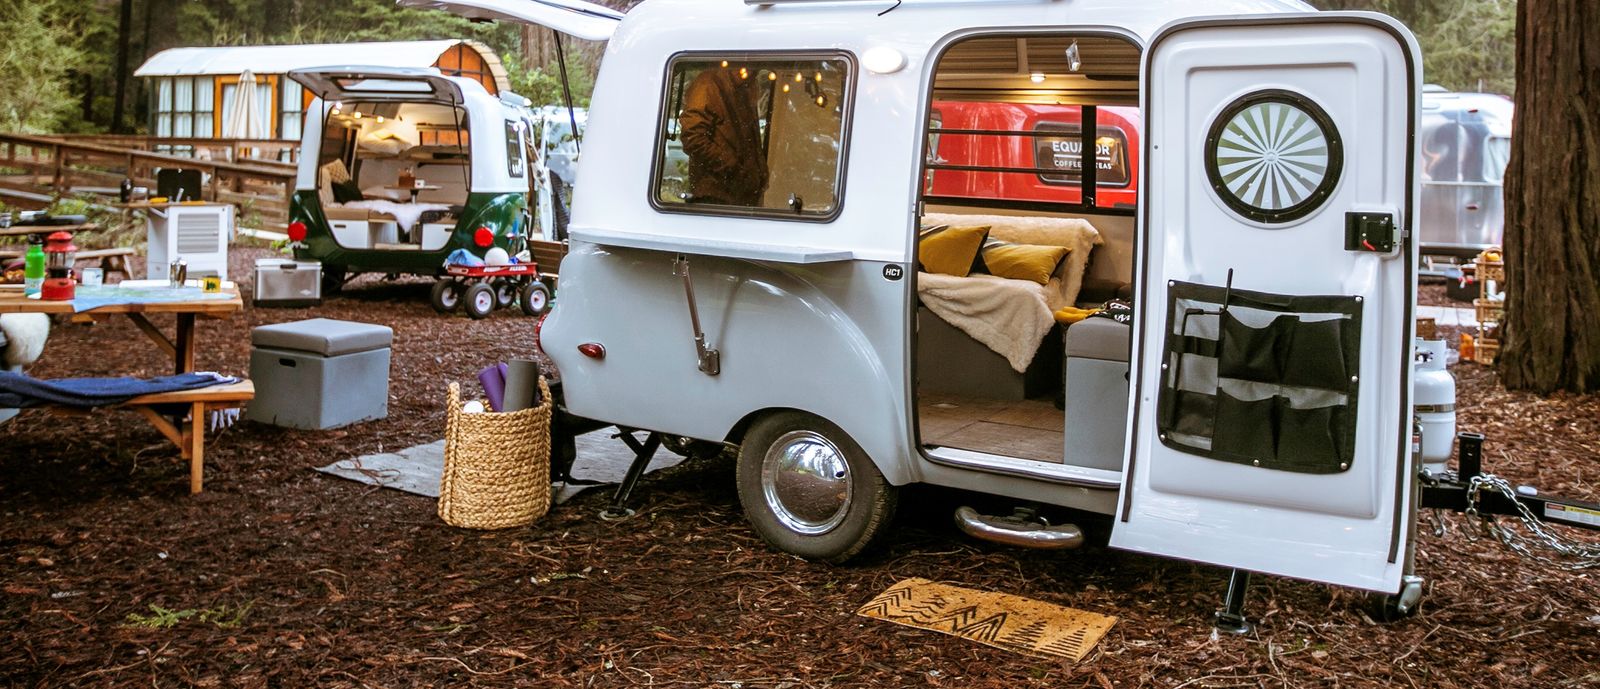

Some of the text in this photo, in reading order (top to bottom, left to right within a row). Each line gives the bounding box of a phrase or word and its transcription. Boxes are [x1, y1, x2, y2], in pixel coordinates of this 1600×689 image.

[1052, 141, 1110, 155] EQUOR
[1054, 160, 1082, 168] COFFEE
[885, 268, 901, 276] HC1
